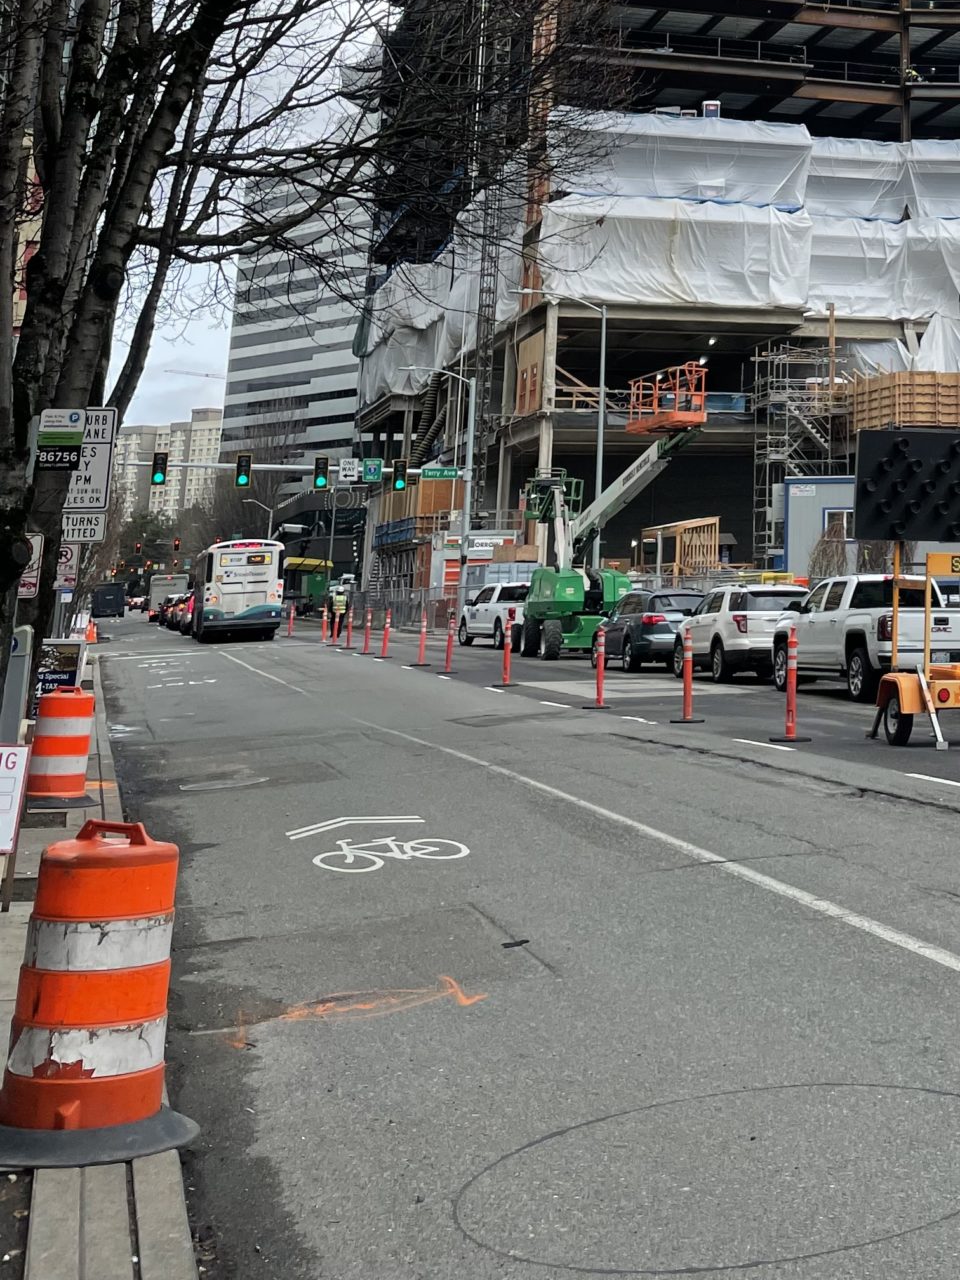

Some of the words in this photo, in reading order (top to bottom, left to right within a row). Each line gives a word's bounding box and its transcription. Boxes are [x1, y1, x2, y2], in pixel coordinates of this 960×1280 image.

[87, 414, 108, 426] URB
[85, 428, 106, 439] ANE
[39, 451, 78, 462] 86756
[81, 446, 97, 458] ES
[75, 475, 92, 485] PM
[65, 516, 100, 527] TURNS
[63, 527, 96, 538] ITTED
[44, 672, 69, 680] Special
